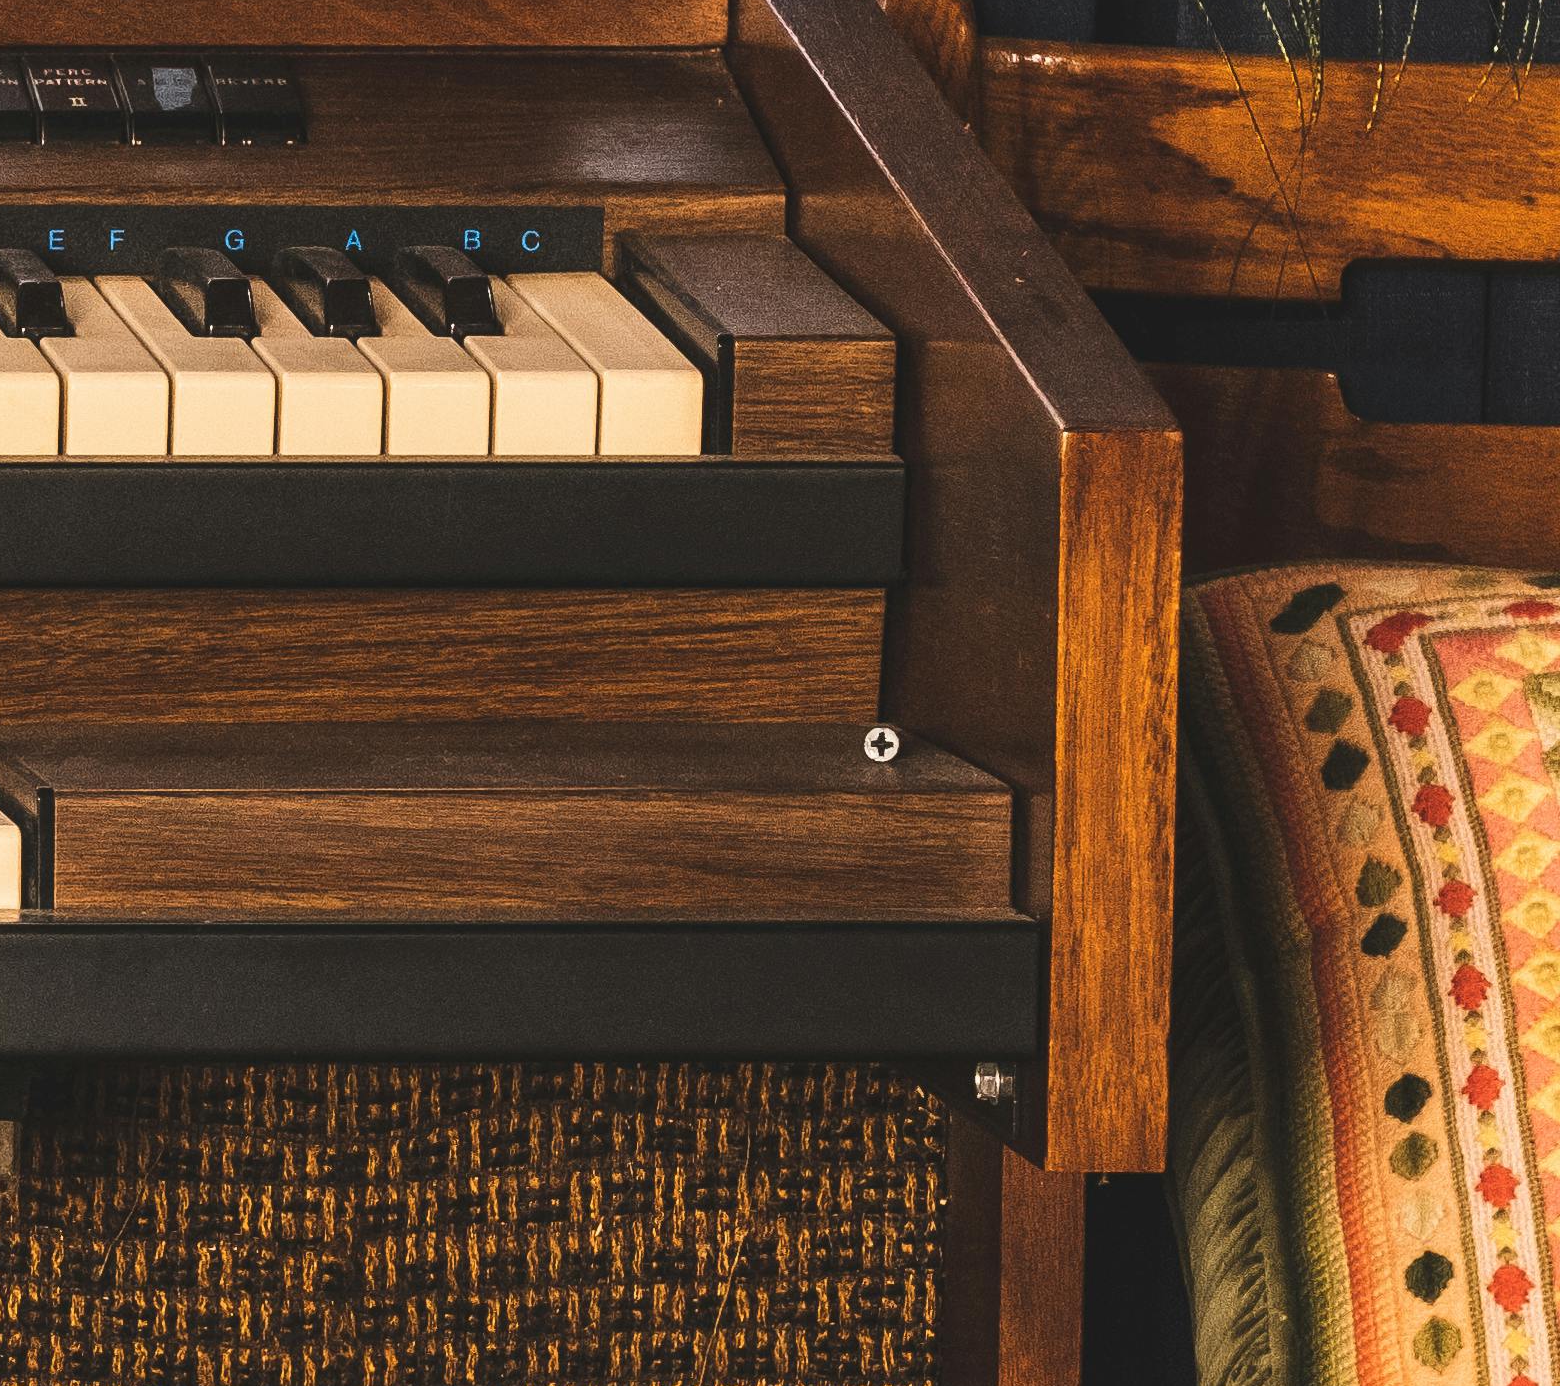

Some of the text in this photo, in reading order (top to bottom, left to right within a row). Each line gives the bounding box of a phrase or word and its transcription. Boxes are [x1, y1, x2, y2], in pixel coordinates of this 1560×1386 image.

[43, 68, 92, 76] PERC
[33, 78, 108, 86] PATTERN
[48, 229, 65, 252] E
[109, 229, 125, 252] F
[224, 229, 245, 252] G
[345, 229, 362, 252] A
[463, 229, 481, 252] B
[521, 229, 541, 252] C
